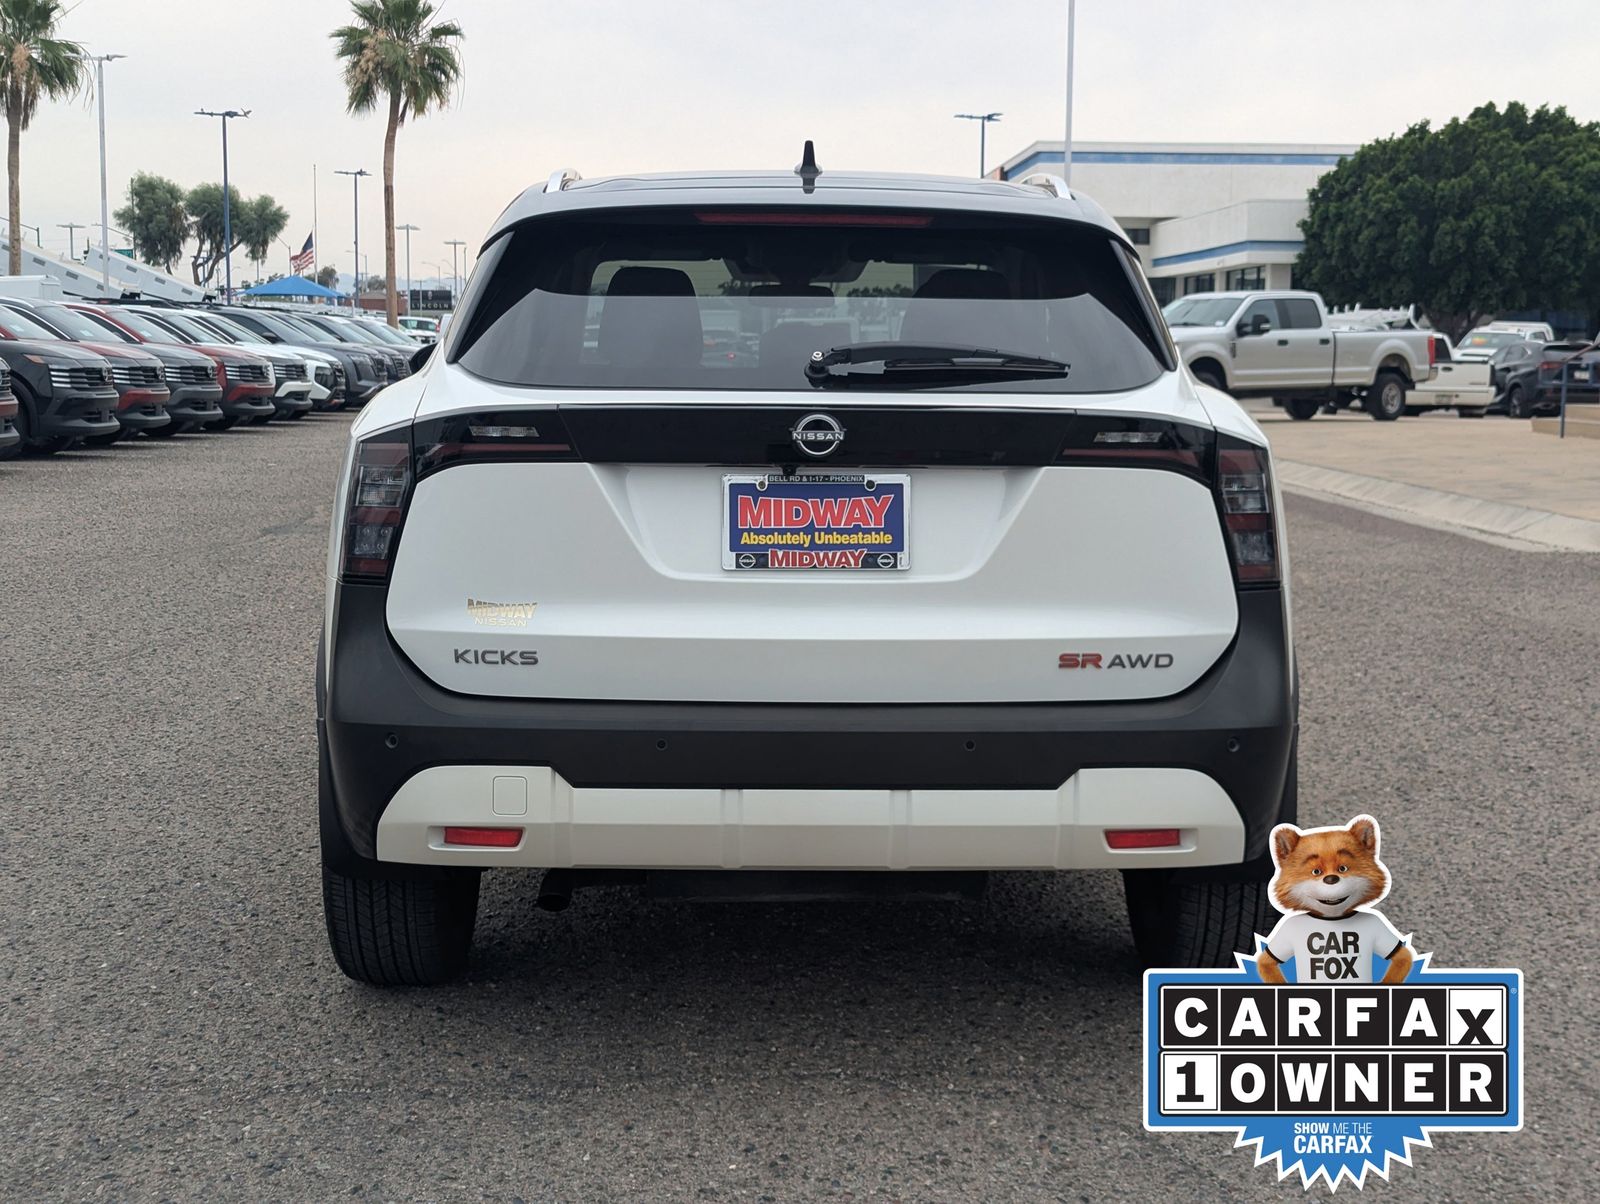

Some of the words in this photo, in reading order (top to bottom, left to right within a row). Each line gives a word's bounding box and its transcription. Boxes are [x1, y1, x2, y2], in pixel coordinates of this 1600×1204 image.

[792, 432, 844, 440] NISSAN
[738, 494, 894, 528] MIDWAY
[741, 532, 811, 547] Absolutely
[815, 532, 892, 545] Unbeatable
[769, 548, 867, 568] MIDWAY
[467, 598, 538, 619] MIDWAY
[474, 617, 527, 627] NISSAN
[454, 649, 539, 665] KICKS
[1058, 653, 1102, 669] SR
[1107, 653, 1174, 669] AWD
